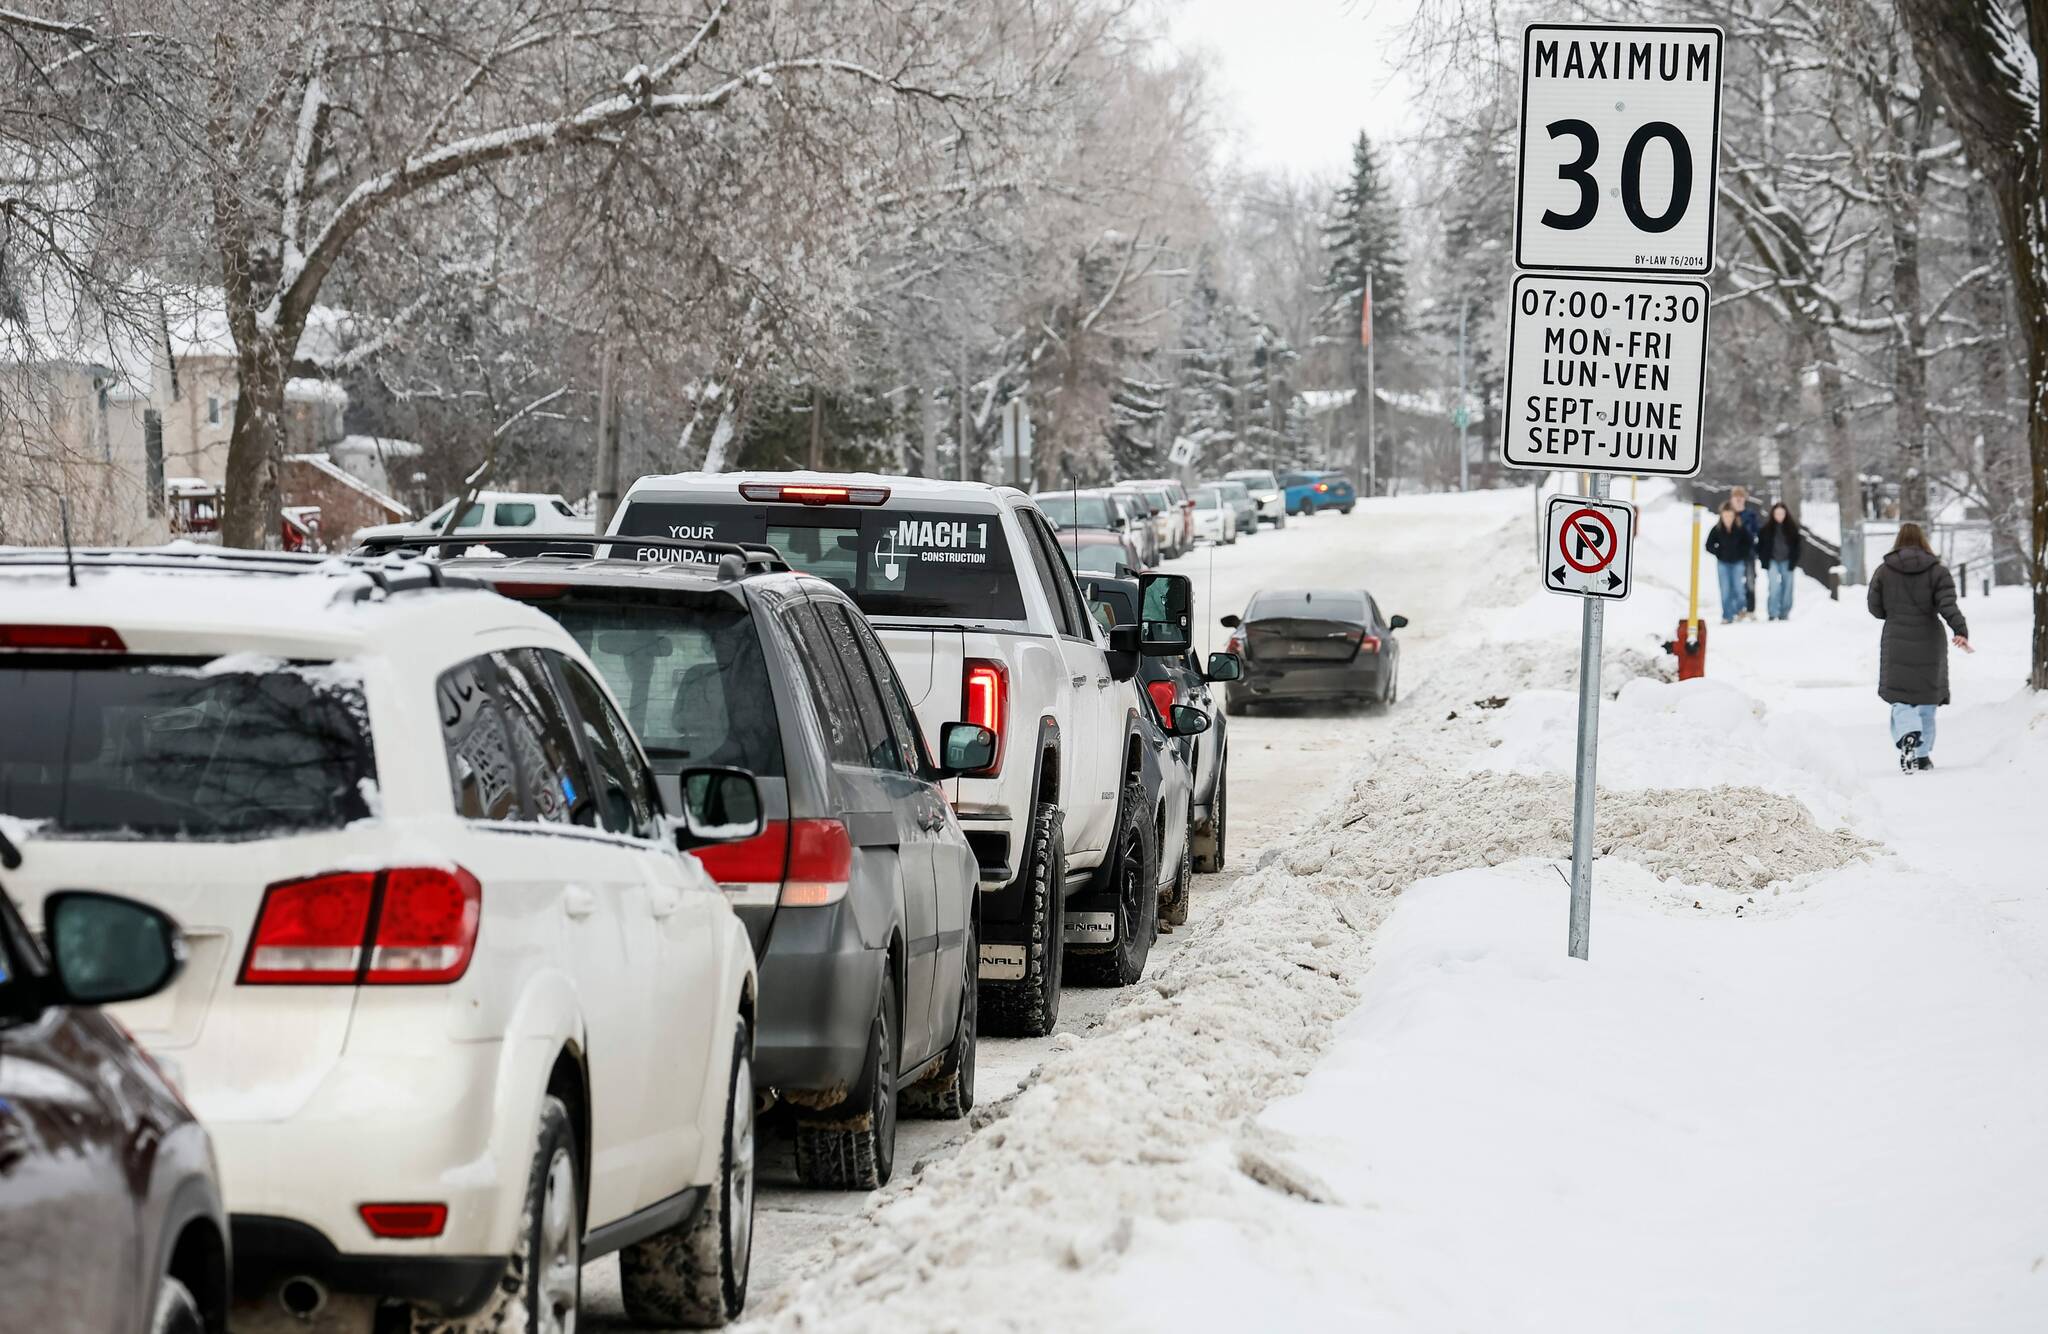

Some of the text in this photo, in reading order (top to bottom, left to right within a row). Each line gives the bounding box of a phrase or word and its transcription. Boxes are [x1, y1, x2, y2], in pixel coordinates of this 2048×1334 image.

[1535, 40, 1711, 81] MAXIMUM
[1540, 118, 1693, 234] 30
[1635, 255, 1704, 267] BY-LAW 76/2014
[1521, 288, 1699, 324] 07:00-17:30
[1544, 327, 1672, 360] MON-FRI
[1542, 358, 1670, 391] LUN-VEN
[1527, 426, 1677, 461] SEPT-JUIN
[668, 525, 714, 539] YOUR
[898, 520, 987, 549] MACH 1
[921, 551, 986, 564] CONSTRUCTION
[1064, 923, 1112, 932] ENALI
[980, 957, 1023, 966] NALI
